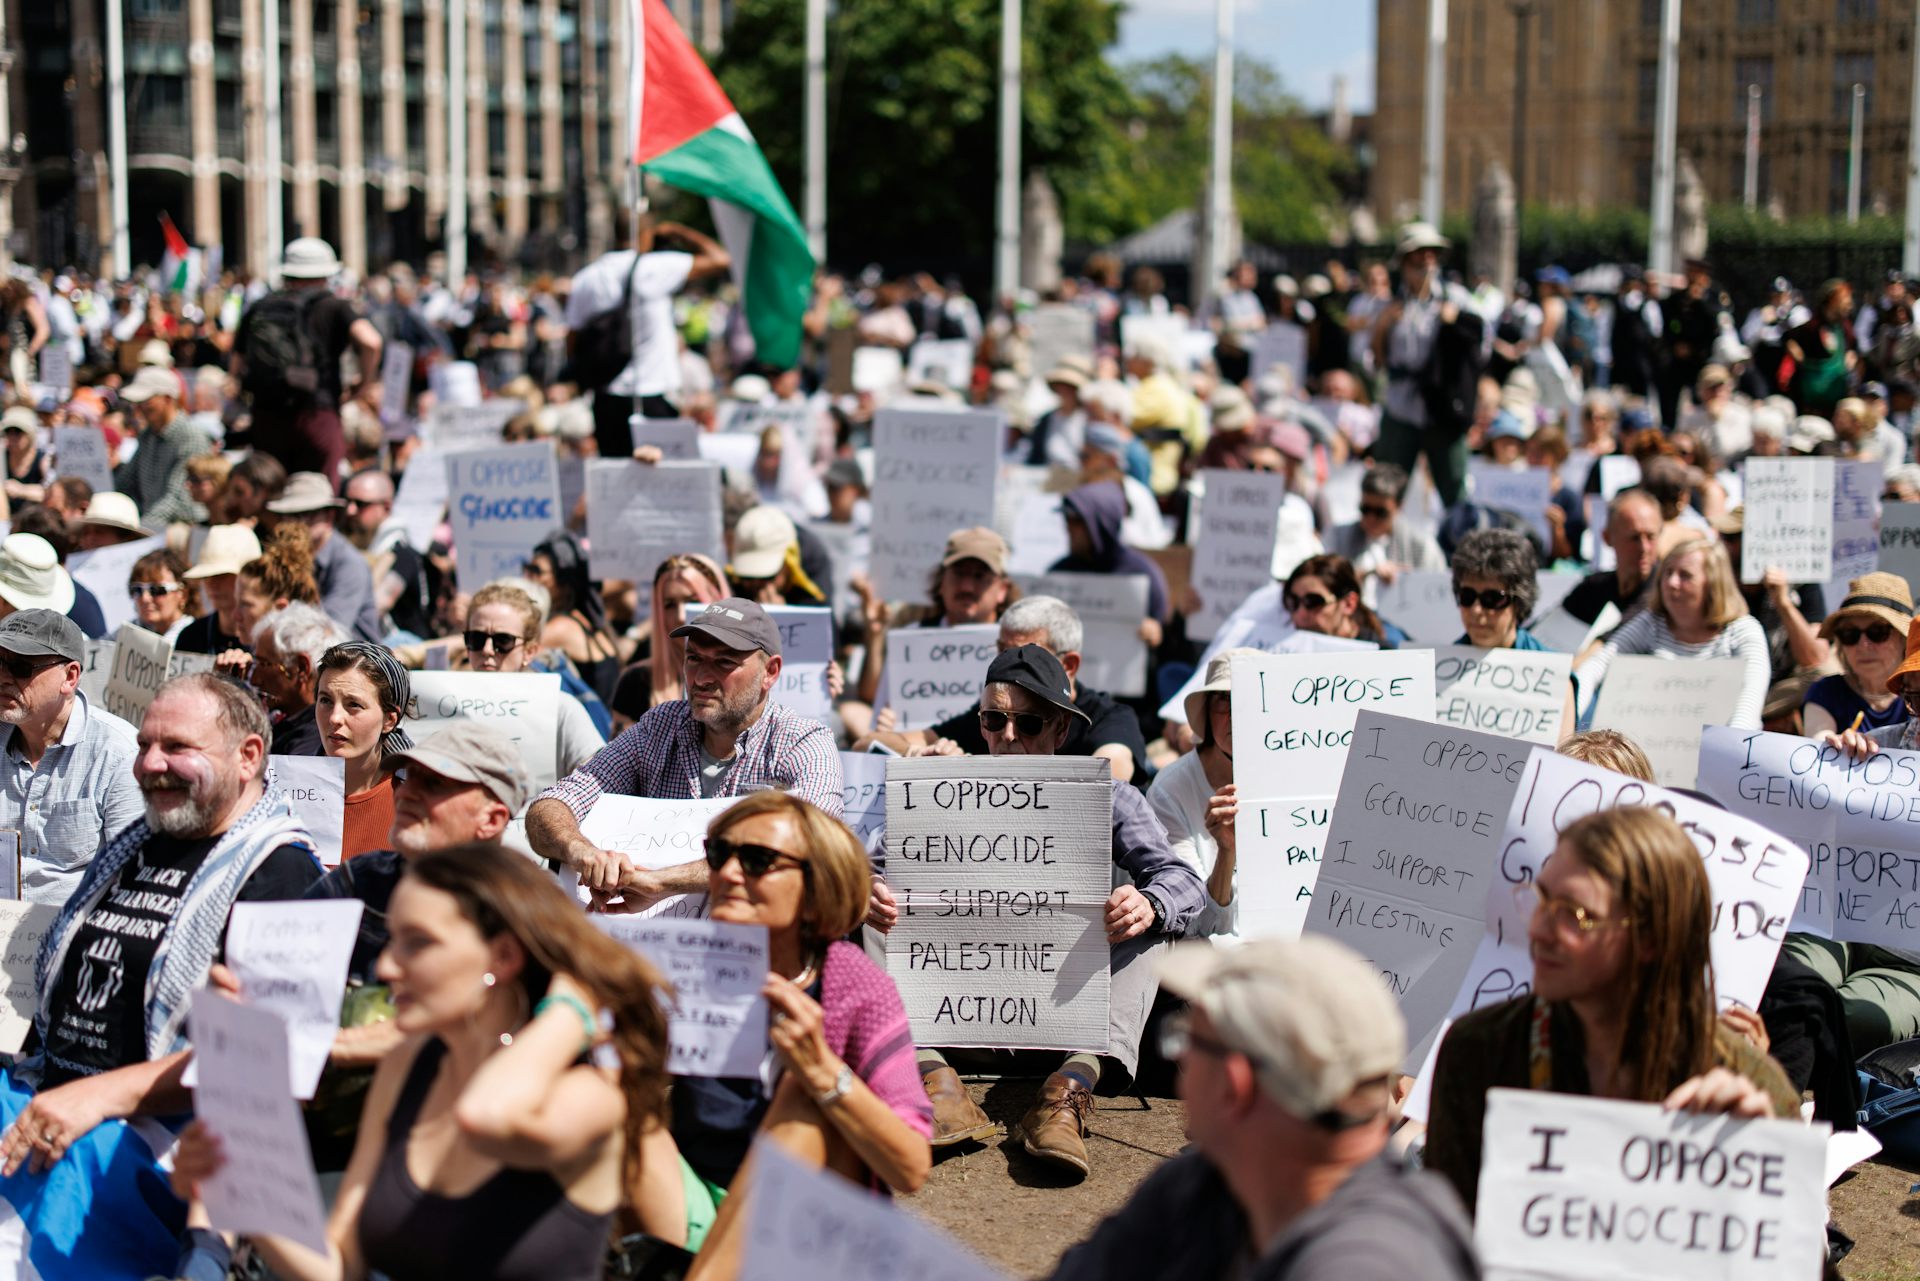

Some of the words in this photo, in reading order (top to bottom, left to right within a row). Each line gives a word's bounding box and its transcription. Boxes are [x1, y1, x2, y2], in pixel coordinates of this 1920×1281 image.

[905, 644, 910, 662] I
[930, 643, 997, 662] OPPO
[1259, 671, 1269, 712] I
[1291, 676, 1413, 706] OPPOSE
[1435, 657, 1555, 697] OPPOSE
[438, 694, 529, 718] OPPOSE
[1436, 697, 1559, 738] ENOCIDE
[1365, 728, 1390, 760] I
[1422, 740, 1525, 784] OPPOSE
[1740, 733, 1763, 771] I
[1789, 744, 1920, 792] OPPOS
[281, 788, 326, 802] IDE.
[902, 782, 917, 811] I
[933, 780, 1050, 811] OPPOSE
[1520, 757, 1542, 827] I
[1260, 808, 1268, 837] I
[1364, 783, 1495, 838] GENOCIDE
[902, 834, 1057, 865] GENOCIDE
[1333, 840, 1357, 864] I
[1373, 849, 1474, 893] SUPPORT
[135, 865, 187, 889] BLACK
[903, 888, 917, 917] I
[934, 888, 1070, 918] SUPPORT
[1328, 890, 1454, 948] PALESTINE
[85, 908, 167, 940] CAMPAIGN
[909, 942, 1056, 973] PALESTINE
[934, 996, 1037, 1027] ACTION
[1529, 1126, 1567, 1173] I
[1620, 1134, 1785, 1197] OPPOSE
[1521, 1193, 1783, 1260] GENOCIDE
